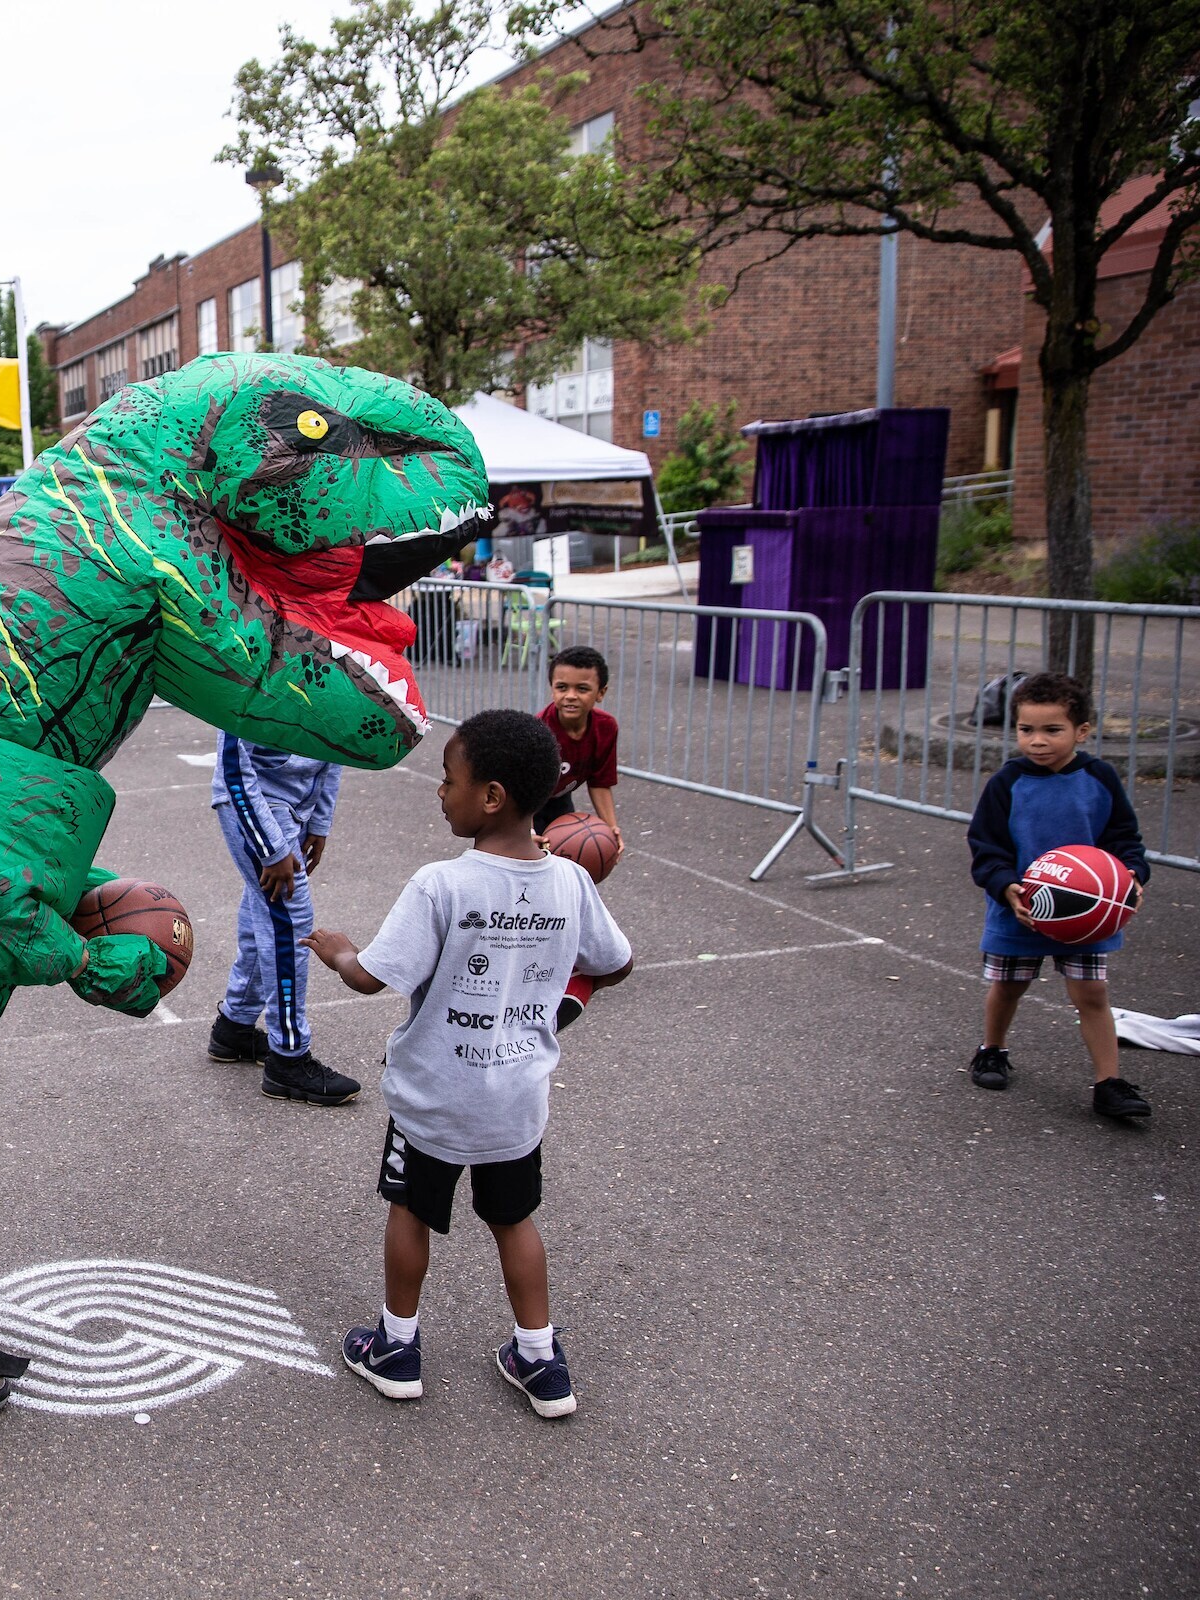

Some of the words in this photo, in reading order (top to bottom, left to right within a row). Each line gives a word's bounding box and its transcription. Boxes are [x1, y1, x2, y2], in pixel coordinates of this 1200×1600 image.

[453, 975, 500, 986] FREEMAN
[447, 1007, 495, 1030] POIC
[503, 1004, 546, 1024] PARR
[502, 1020, 547, 1029] LUBER
